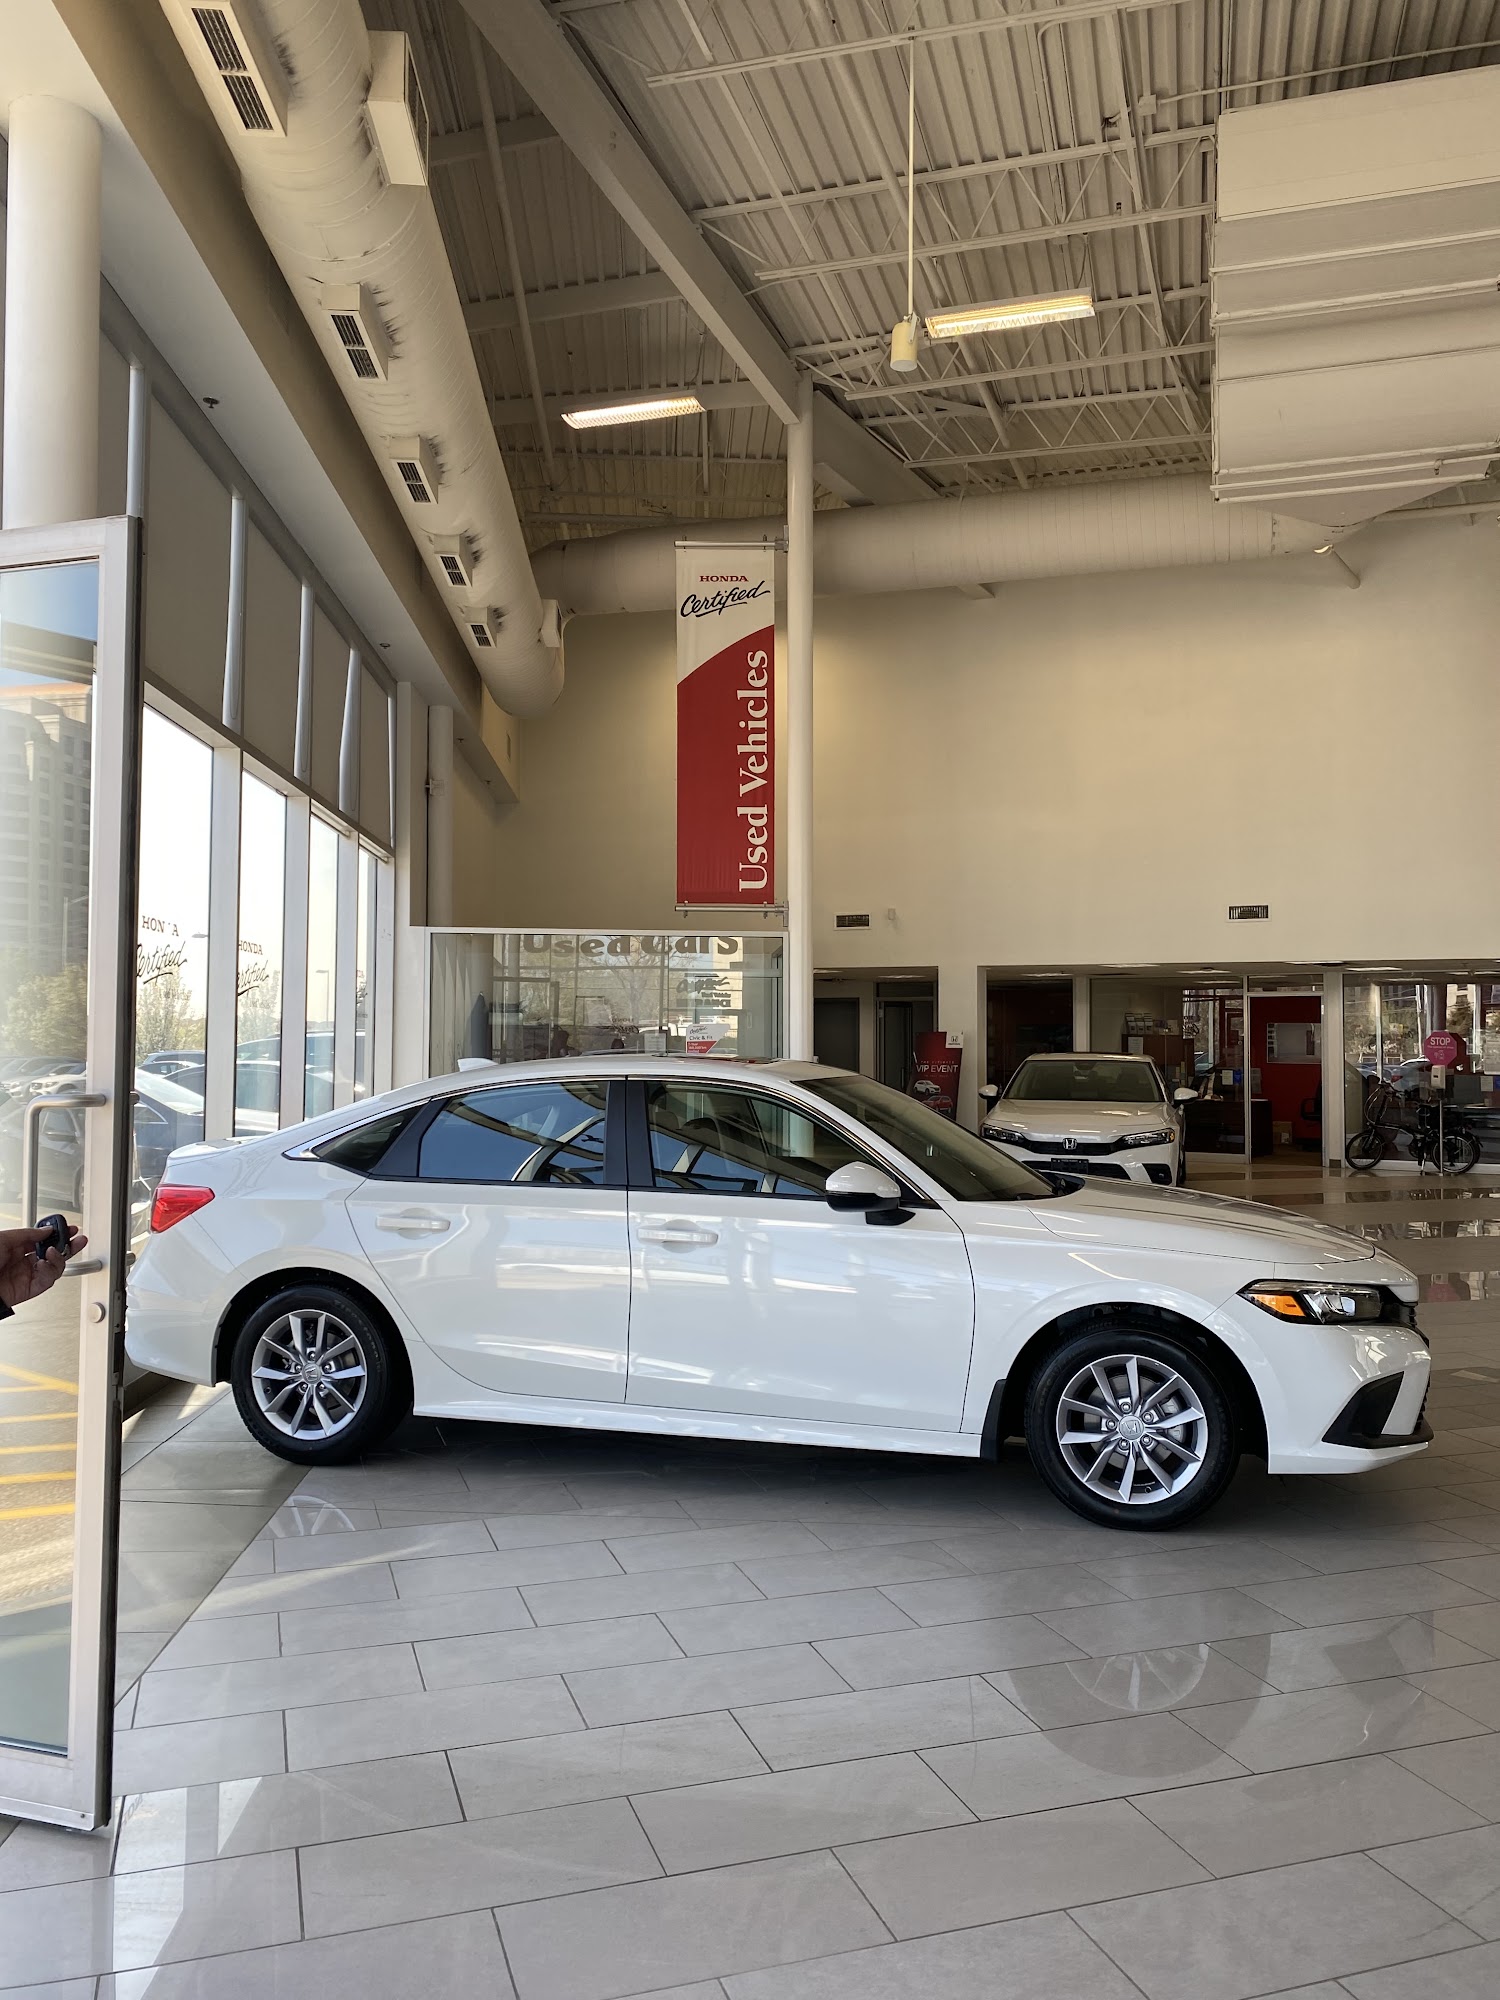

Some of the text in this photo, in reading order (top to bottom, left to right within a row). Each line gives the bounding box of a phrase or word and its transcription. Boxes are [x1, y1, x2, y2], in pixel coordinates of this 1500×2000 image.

[699, 575, 749, 583] HONDA
[680, 580, 771, 618] Certified
[737, 649, 768, 893] Used Vehicles
[141, 915, 179, 937] HONA
[1430, 1037, 1450, 1045] STOP
[916, 1064, 958, 1072] VIP EVENT
